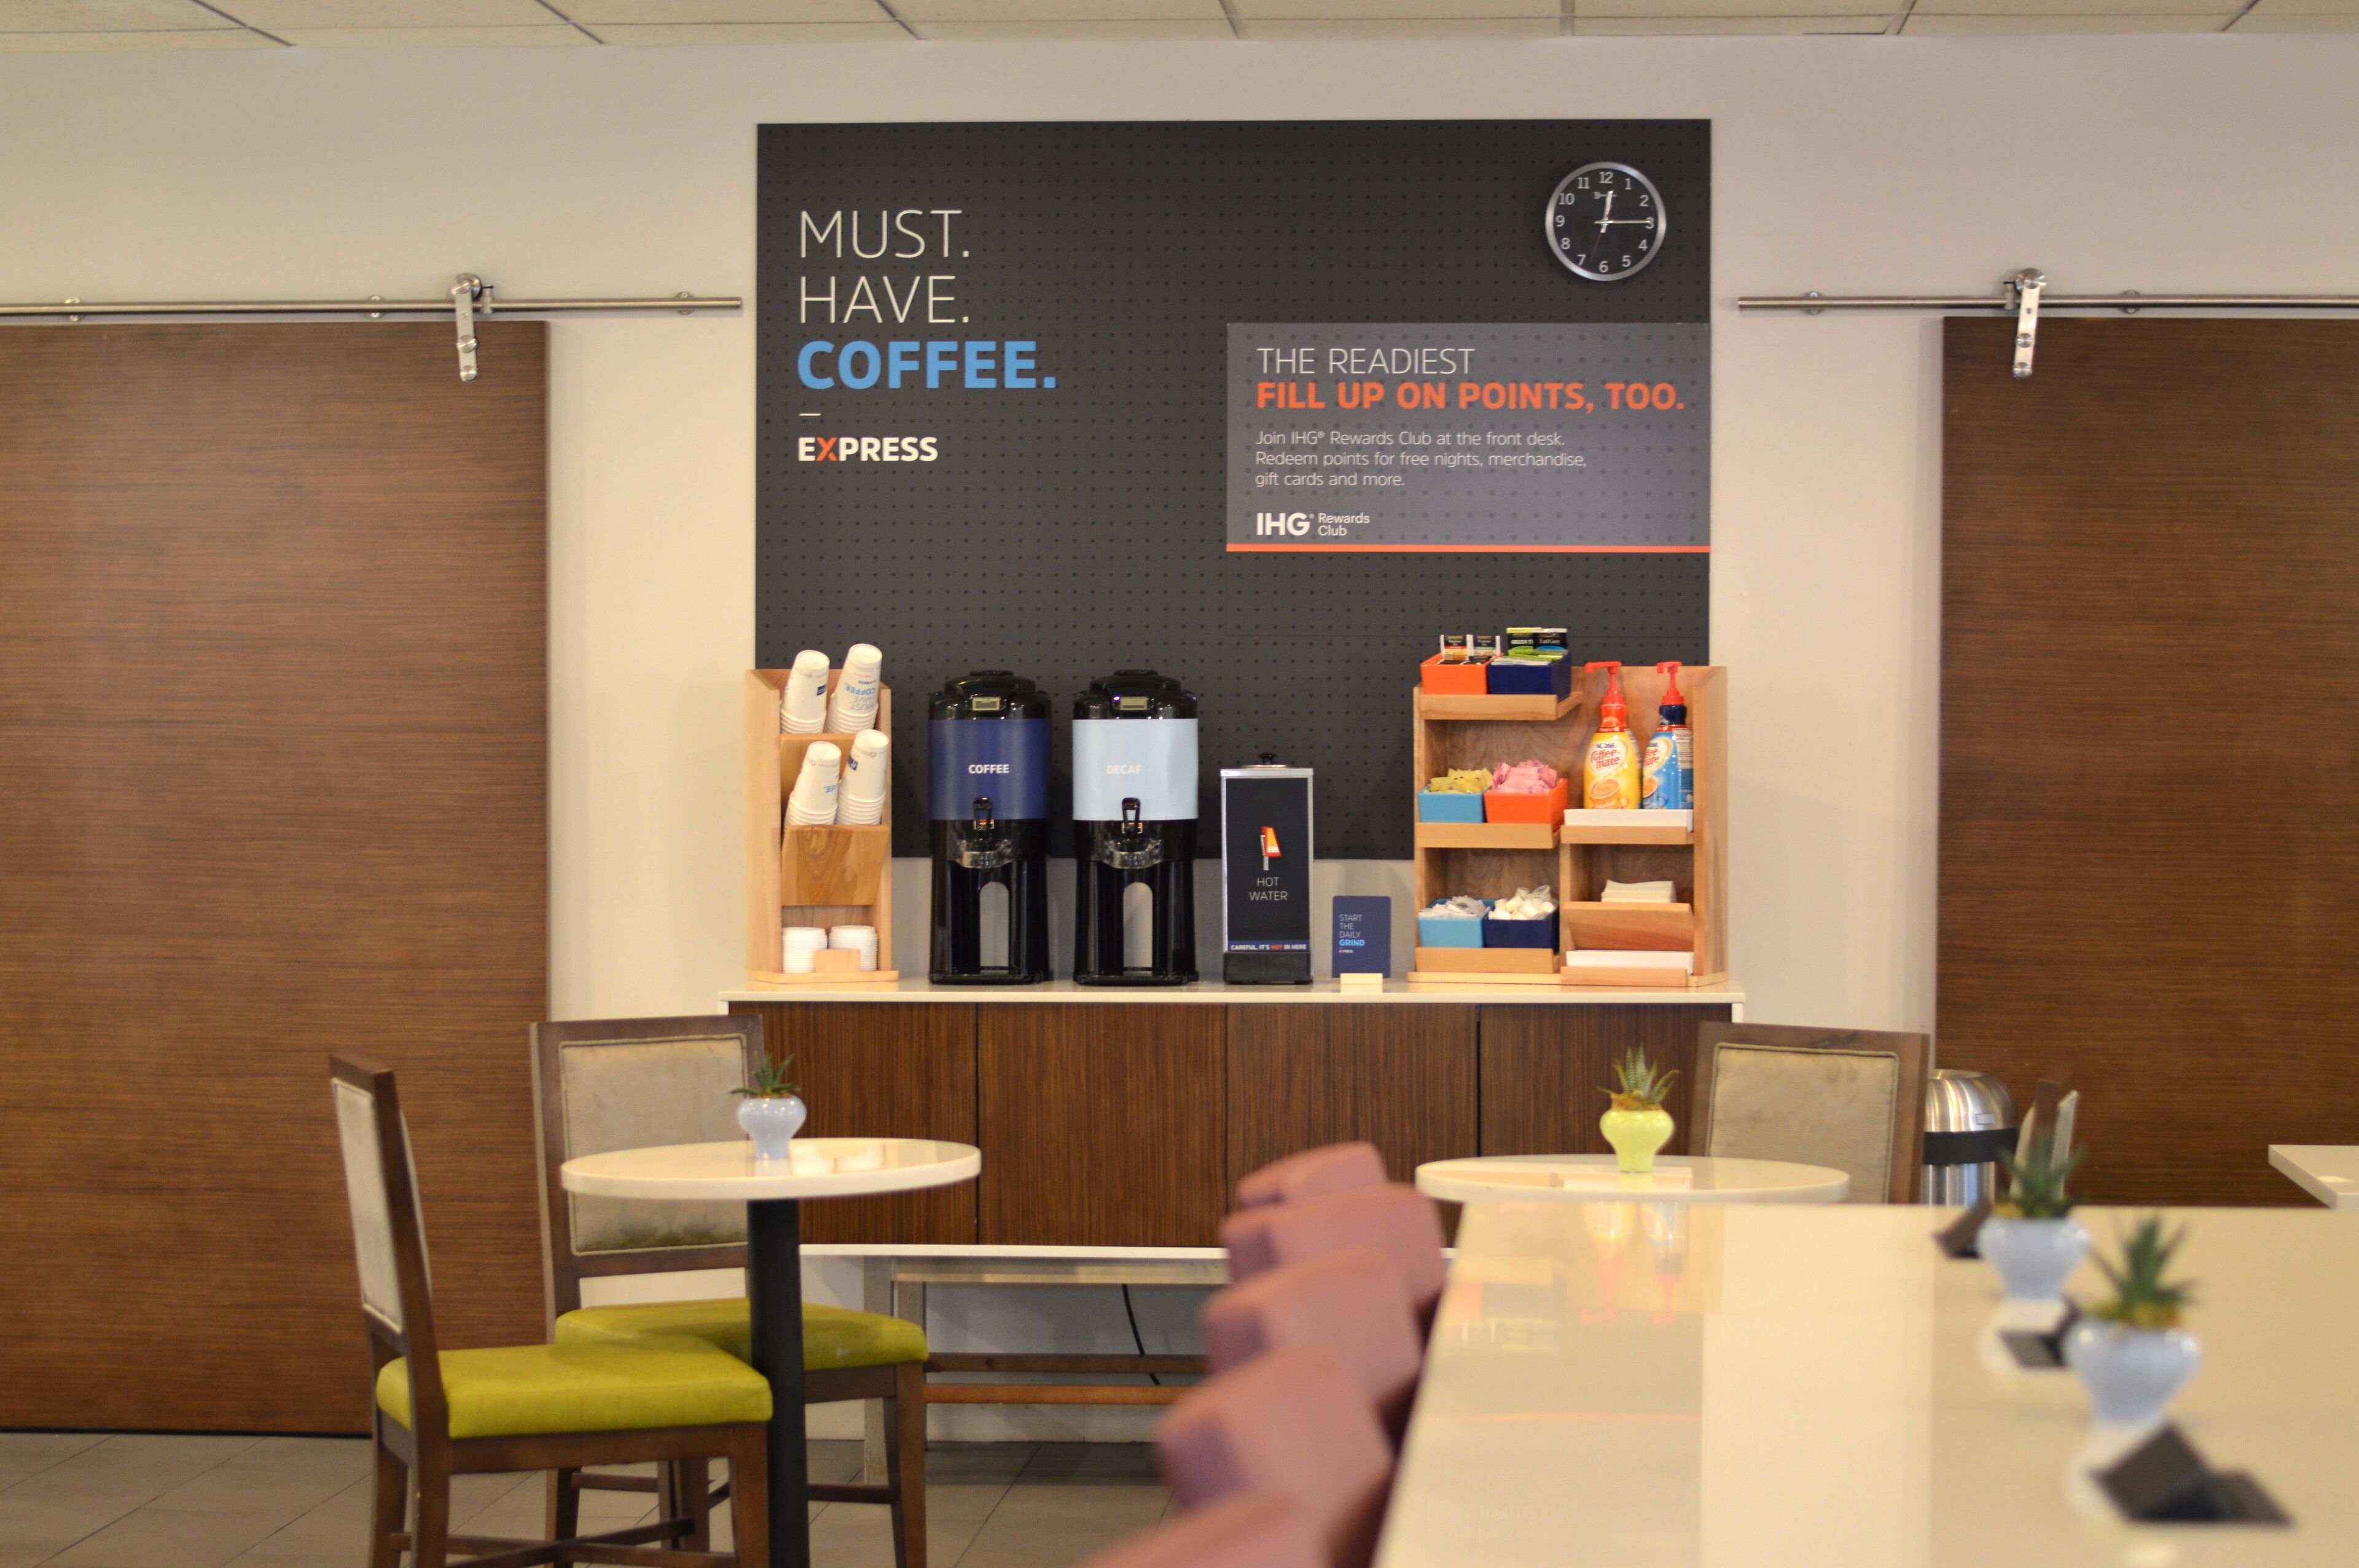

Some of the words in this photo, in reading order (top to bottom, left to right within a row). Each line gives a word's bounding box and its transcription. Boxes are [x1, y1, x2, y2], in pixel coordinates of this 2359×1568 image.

[1576, 177, 1590, 189] 11
[1598, 171, 1614, 184] 12
[1624, 178, 1632, 190] 1
[1558, 193, 1575, 205] 10
[1640, 195, 1649, 206] 2
[1555, 216, 1565, 227] 9
[1645, 217, 1654, 229] 3
[800, 209, 969, 258] MUST.
[1560, 238, 1570, 249] 8
[1638, 239, 1648, 251] 4
[1577, 254, 1586, 266] 7
[1621, 255, 1631, 267] 5
[1598, 260, 1608, 273] 6
[800, 275, 969, 324] HAVE.
[797, 340, 1056, 389] COFFEE.
[1256, 348, 1315, 374] THE
[1328, 348, 1476, 375] READIEST
[1257, 381, 1326, 409] FILL
[1337, 381, 1385, 410] UP
[1396, 381, 1446, 410] ON
[1458, 382, 1594, 414] POINTS,
[1604, 382, 1685, 410] TOO.
[1255, 431, 1286, 445] Join
[1329, 431, 1395, 445] Rewards
[1398, 431, 1432, 445] Club
[1436, 432, 1452, 445] at
[1456, 432, 1481, 446] the
[1486, 431, 1522, 446] front
[1526, 432, 1565, 446] desk.
[797, 436, 939, 462] EXPRESS
[1255, 451, 1318, 466] Redeem
[1323, 452, 1369, 467] points
[1374, 451, 1395, 466] for
[1399, 451, 1430, 466] free
[1434, 452, 1484, 467] nights,
[1488, 452, 1587, 467] merchandise,
[1254, 472, 1280, 487] gift
[1283, 472, 1324, 486] cards
[1328, 472, 1358, 486] and
[1362, 474, 1405, 486] more.
[1318, 512, 1371, 524] Rewards
[1317, 525, 1348, 536] Club
[968, 764, 1010, 774] COFFEE
[1106, 764, 1143, 775] DECAF
[1256, 876, 1280, 887] HOT
[1248, 891, 1288, 901] WATER
